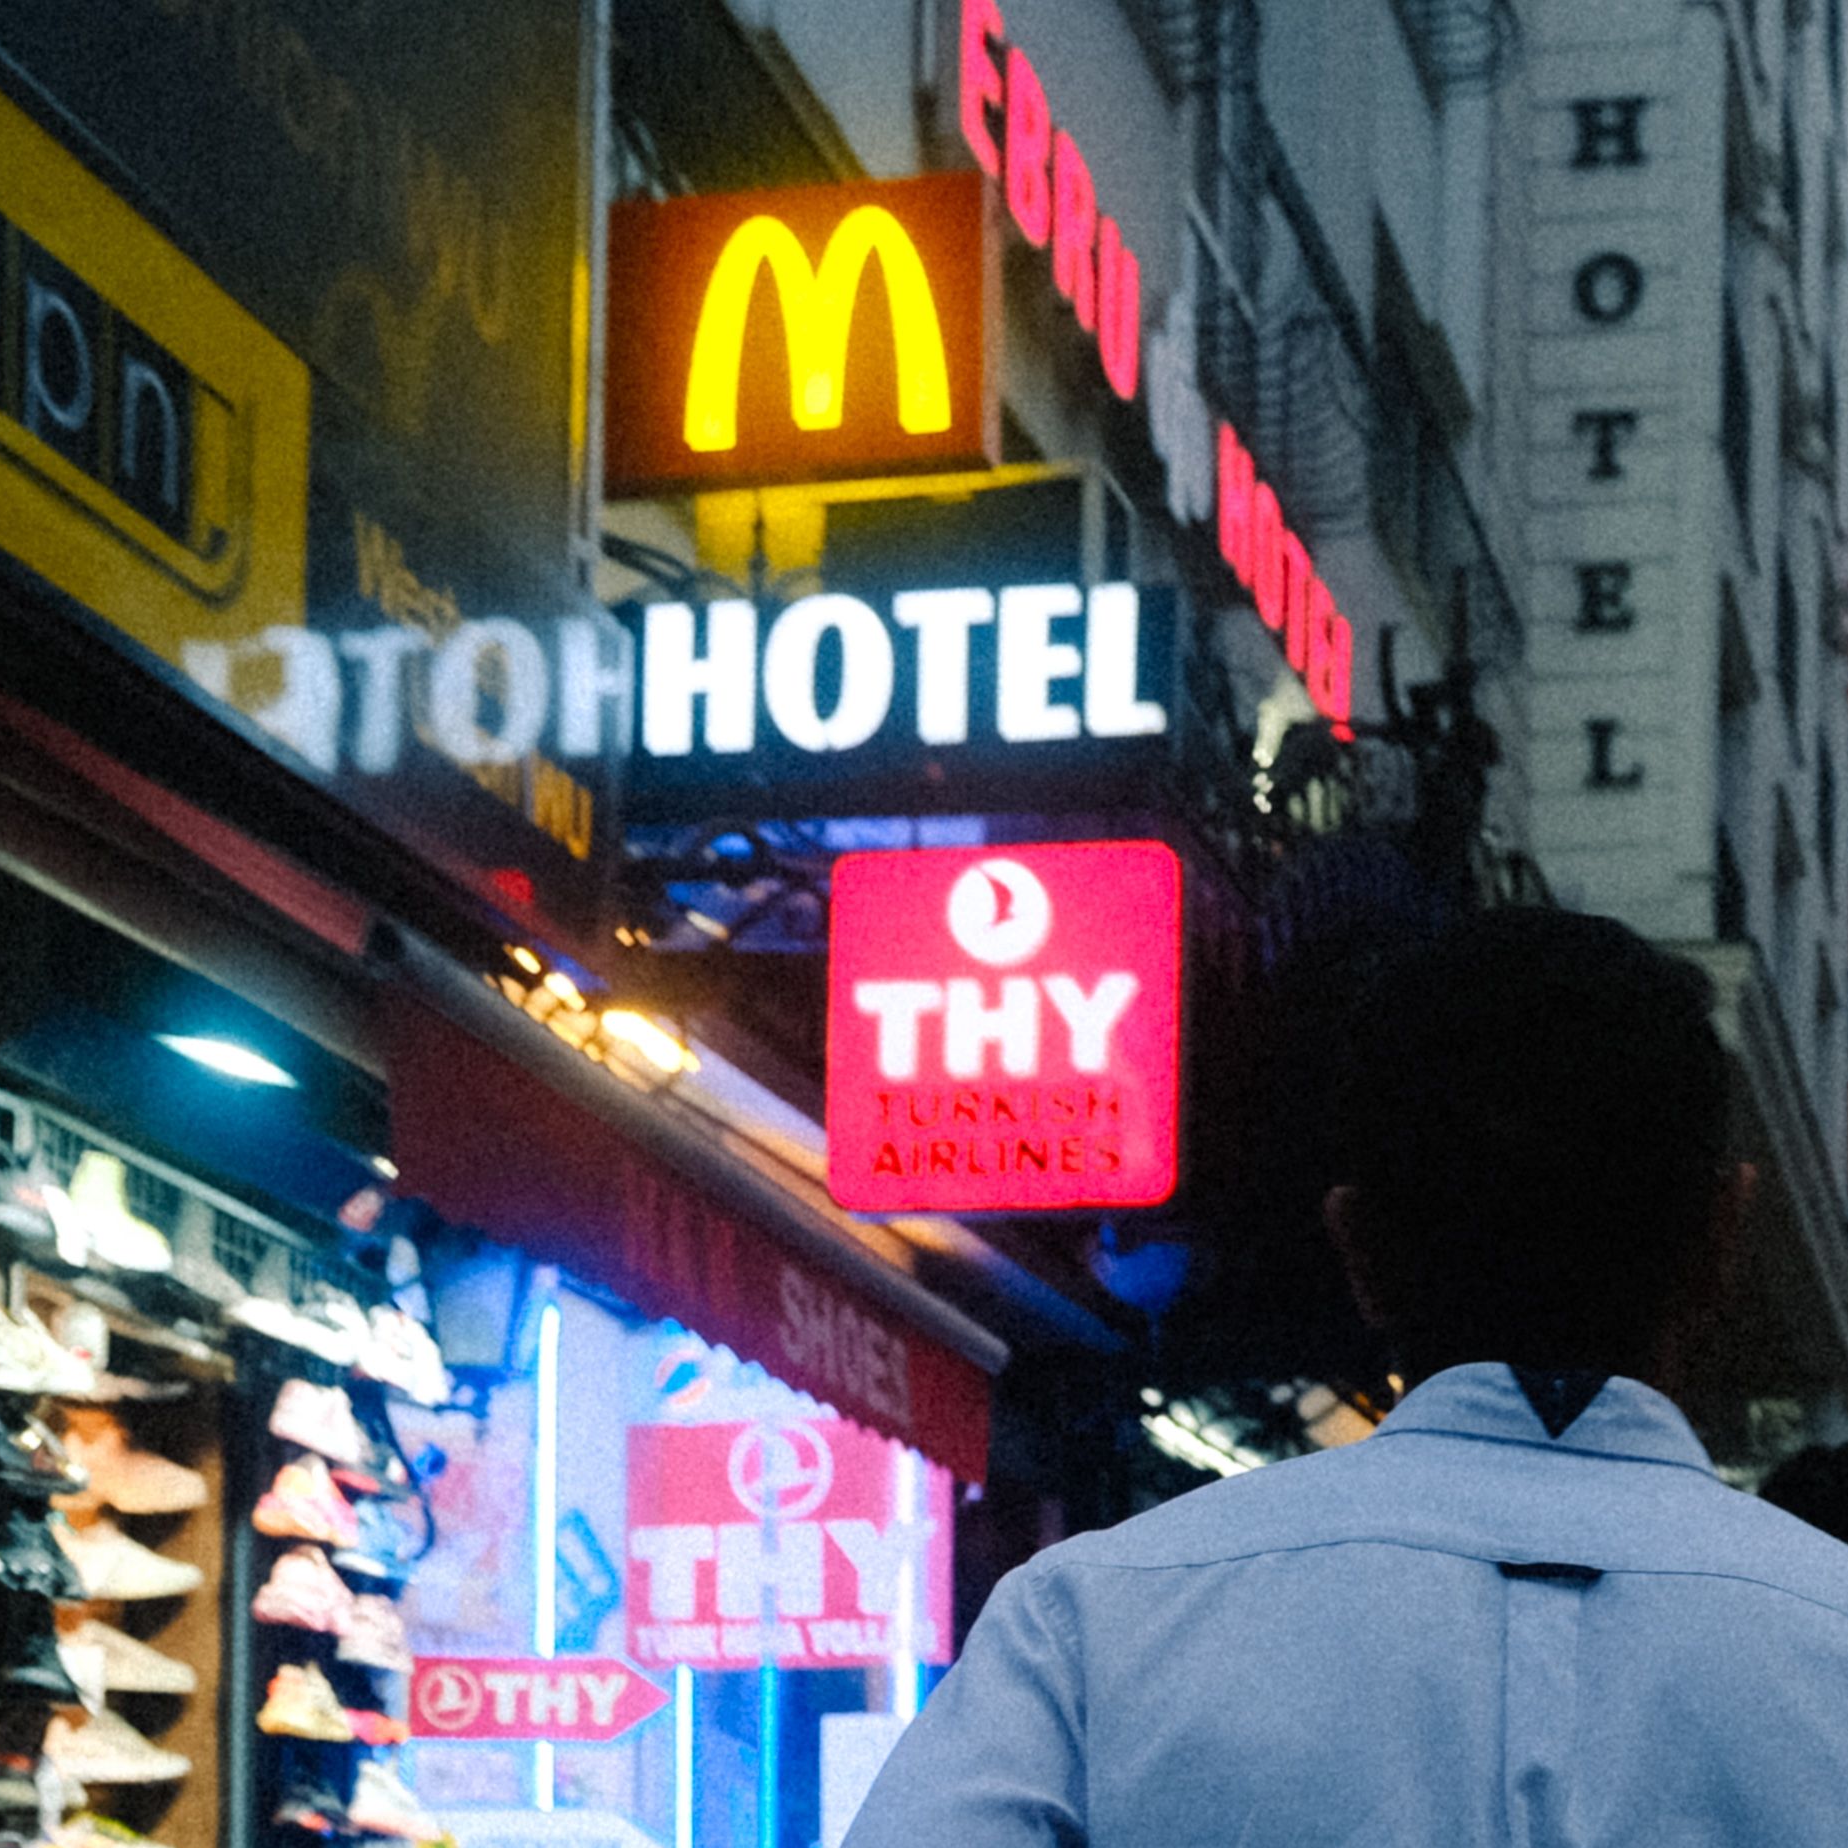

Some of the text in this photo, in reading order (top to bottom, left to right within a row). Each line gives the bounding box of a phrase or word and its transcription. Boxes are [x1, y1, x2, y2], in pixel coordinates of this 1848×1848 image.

[1568, 96, 1649, 791] HOTEL
[641, 582, 1168, 759] HOTEL
[853, 972, 1140, 1082] THY
[872, 1137, 1122, 1176] AIRLINES
[875, 1087, 1121, 1128] TURKISH
[778, 1266, 913, 1428] SHOES
[630, 1518, 939, 1618] THY
[482, 1671, 629, 1728] THY
